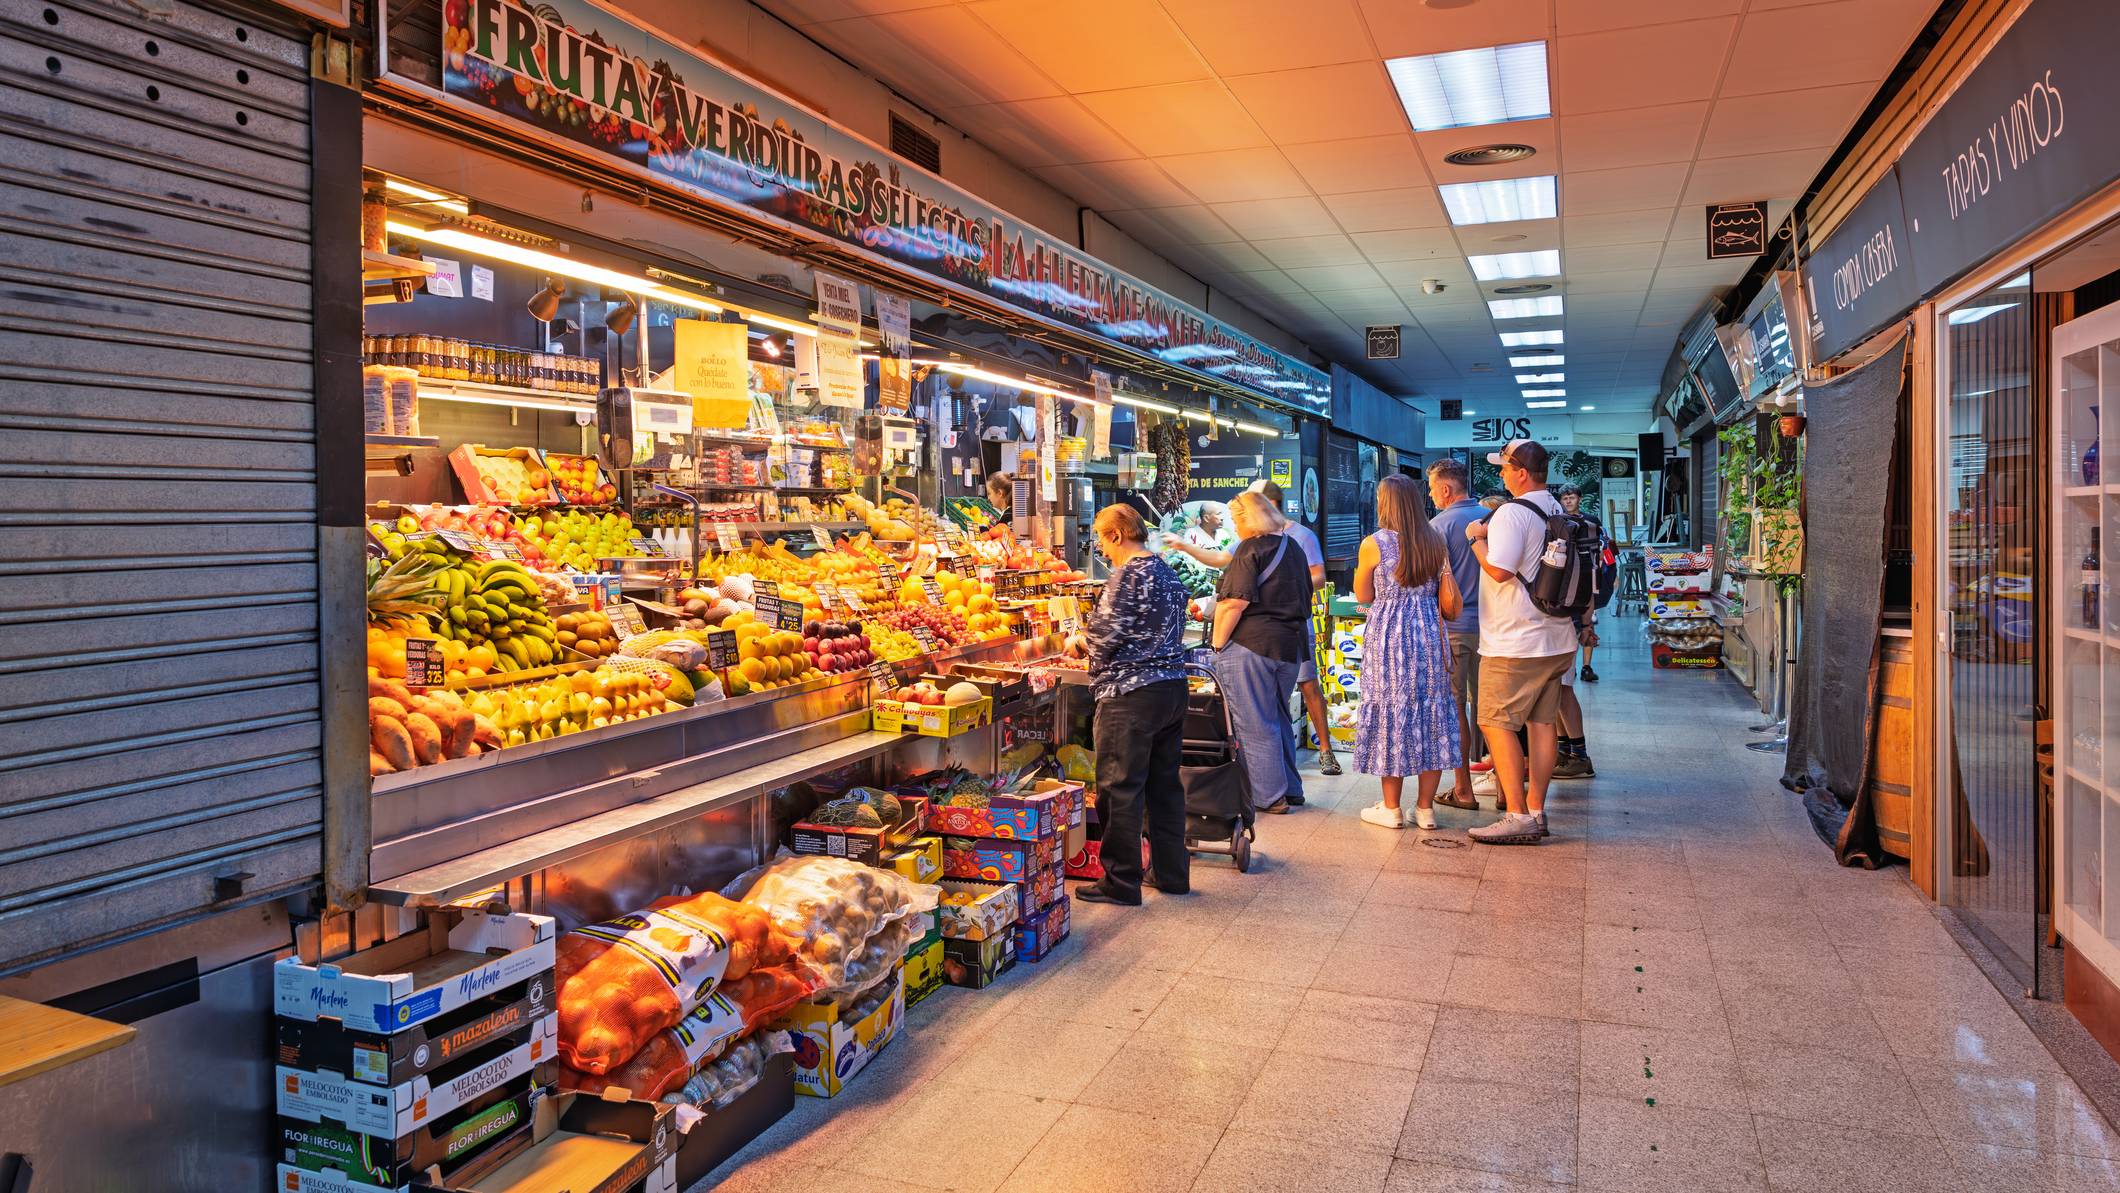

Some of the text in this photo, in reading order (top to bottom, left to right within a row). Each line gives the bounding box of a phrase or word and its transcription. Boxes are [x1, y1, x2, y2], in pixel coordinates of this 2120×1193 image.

[471, 0, 652, 126] FRUTA
[673, 80, 867, 217] VERDURAS
[871, 177, 986, 265] SELECTAS
[991, 216, 1030, 283] LA
[1942, 69, 2065, 221] TAPAS Y VINOS
[1862, 223, 1899, 288] CASERA
[823, 282, 838, 300] VENTA
[828, 303, 859, 324] COSECHERO
[1201, 478, 1211, 488] DE
[1213, 477, 1249, 488] SANCHEZ
[310, 986, 349, 1010] Marlene
[459, 966, 501, 1001] Marlene
[452, 1007, 520, 1048] mazaleón
[301, 1079, 354, 1097] MELOCOTÓN
[452, 1054, 514, 1095] MELOCOTÓN
[458, 1070, 508, 1101] EMBOLSADO
[306, 1089, 348, 1104] EMBOLSADO
[284, 1129, 354, 1154] FLOR IREGUA
[448, 1109, 516, 1155] FLOR IREGUA
